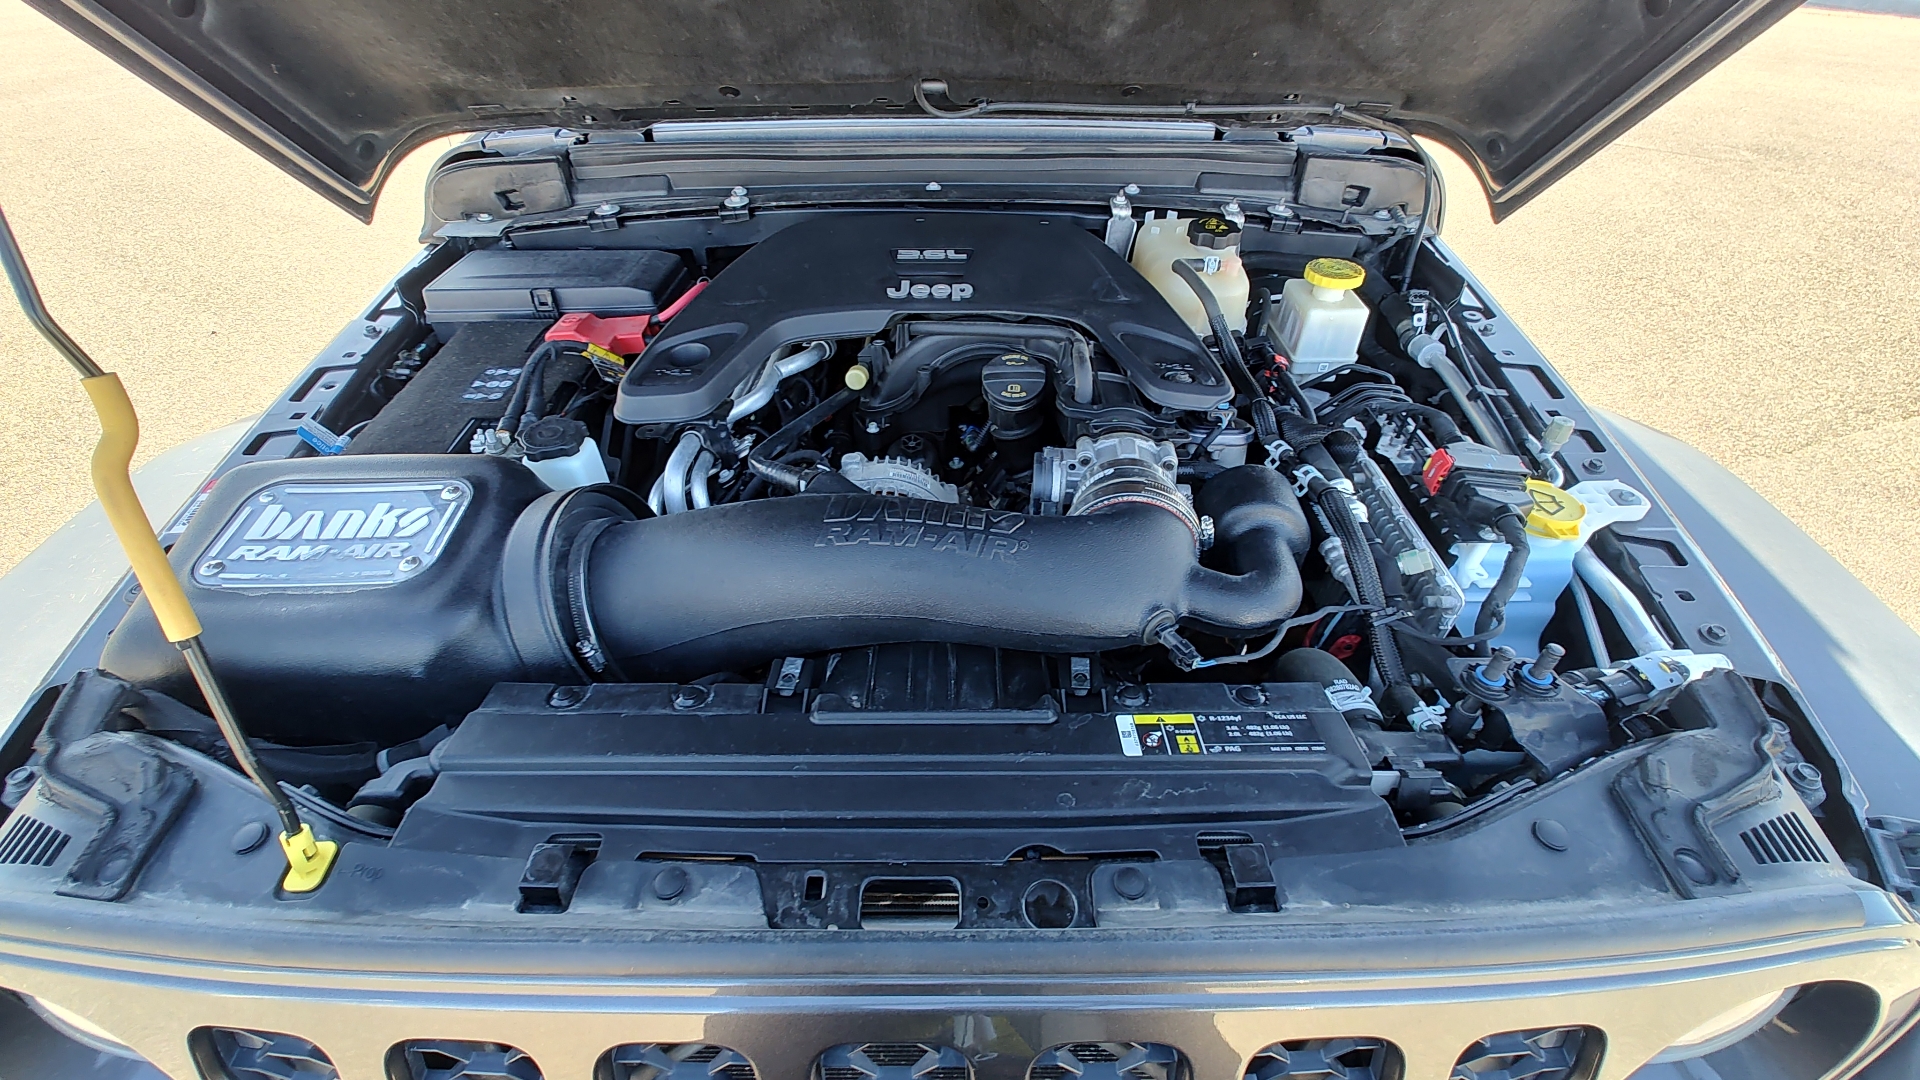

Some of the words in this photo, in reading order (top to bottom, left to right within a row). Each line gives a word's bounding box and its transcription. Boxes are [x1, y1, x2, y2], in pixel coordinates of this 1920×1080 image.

[897, 249, 967, 260] 3.6L
[886, 279, 974, 301] Jeep
[243, 502, 435, 541] banks
[227, 542, 411, 561] RAM-AIR
